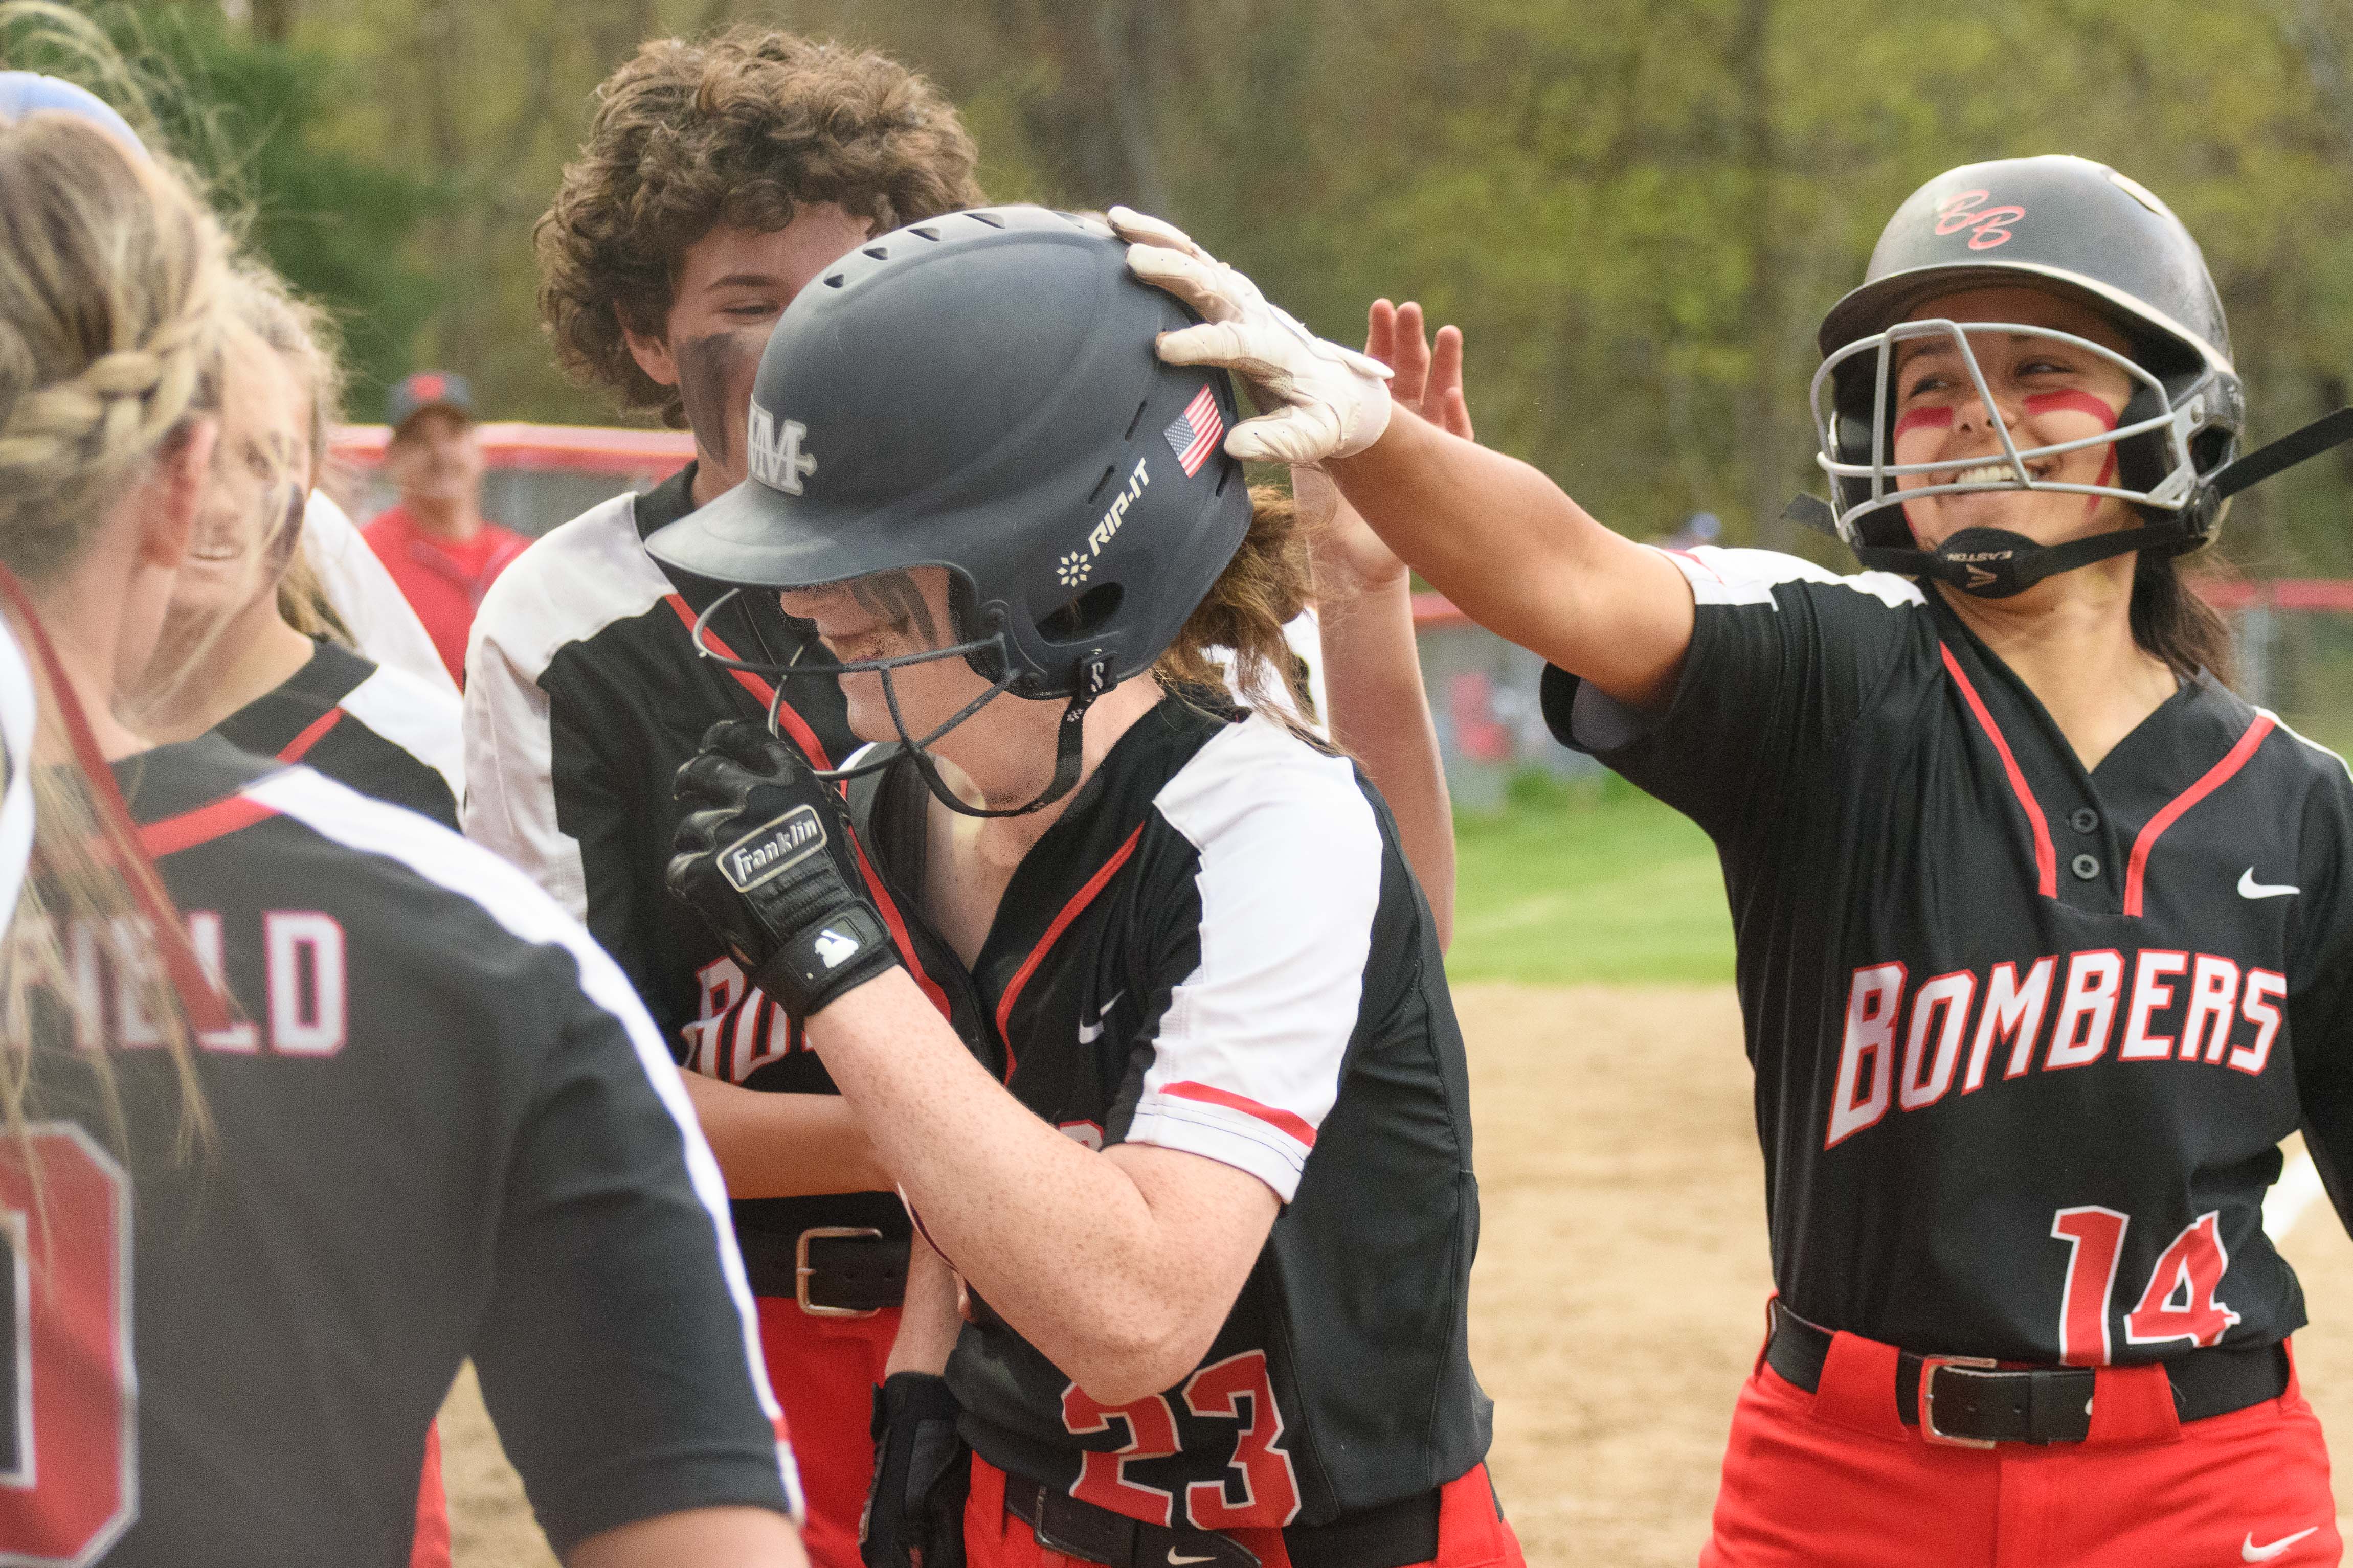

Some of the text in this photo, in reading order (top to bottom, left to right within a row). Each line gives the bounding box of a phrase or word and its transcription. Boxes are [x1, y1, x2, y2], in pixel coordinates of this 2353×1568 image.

[1088, 457, 1150, 557] RIP-IT
[1947, 549, 2013, 562] EASTON
[732, 819, 818, 885] Franklin
[1824, 948, 2288, 1150] BOMBERS
[2050, 1205, 2241, 1366] 14
[1061, 1349, 1302, 1530] 23
